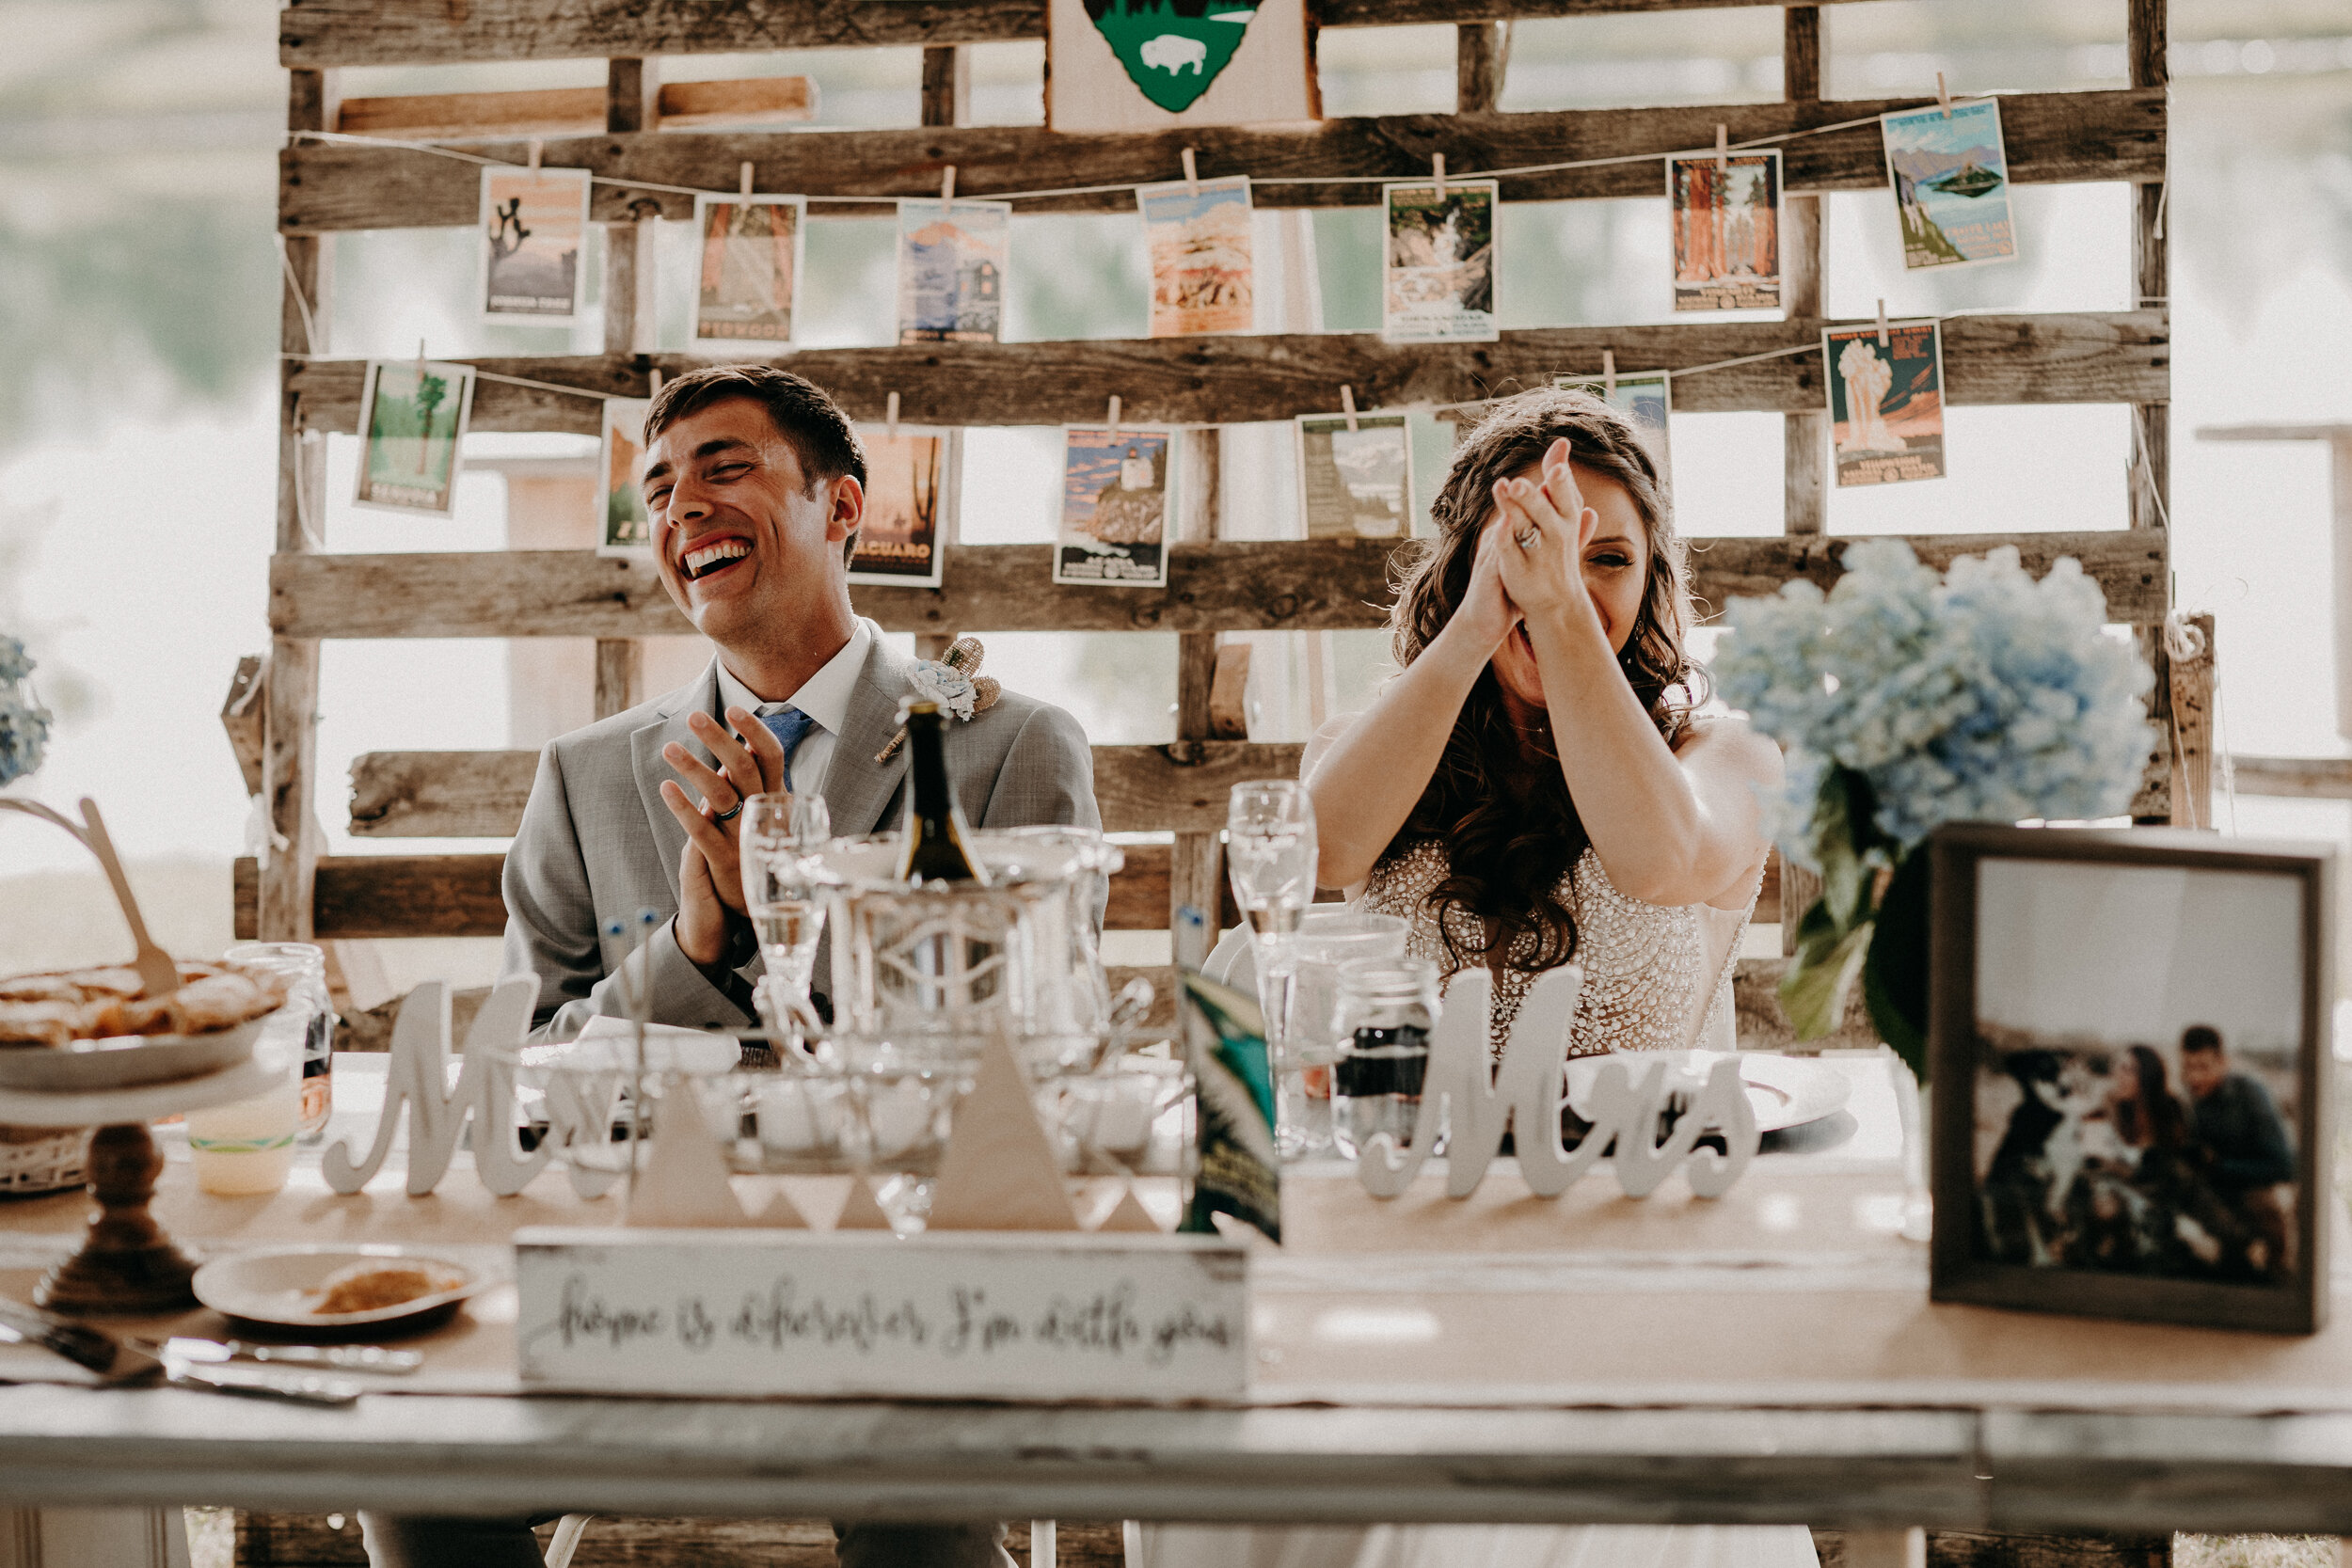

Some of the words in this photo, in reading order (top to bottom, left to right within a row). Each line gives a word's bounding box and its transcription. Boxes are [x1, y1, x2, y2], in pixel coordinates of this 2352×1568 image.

[1358, 965, 1762, 1200] Mrs
[557, 1274, 661, 1350] home
[675, 1292, 716, 1354] is
[941, 1283, 1024, 1359] I'm
[1036, 1276, 1141, 1354] with
[1146, 1301, 1232, 1370] you
